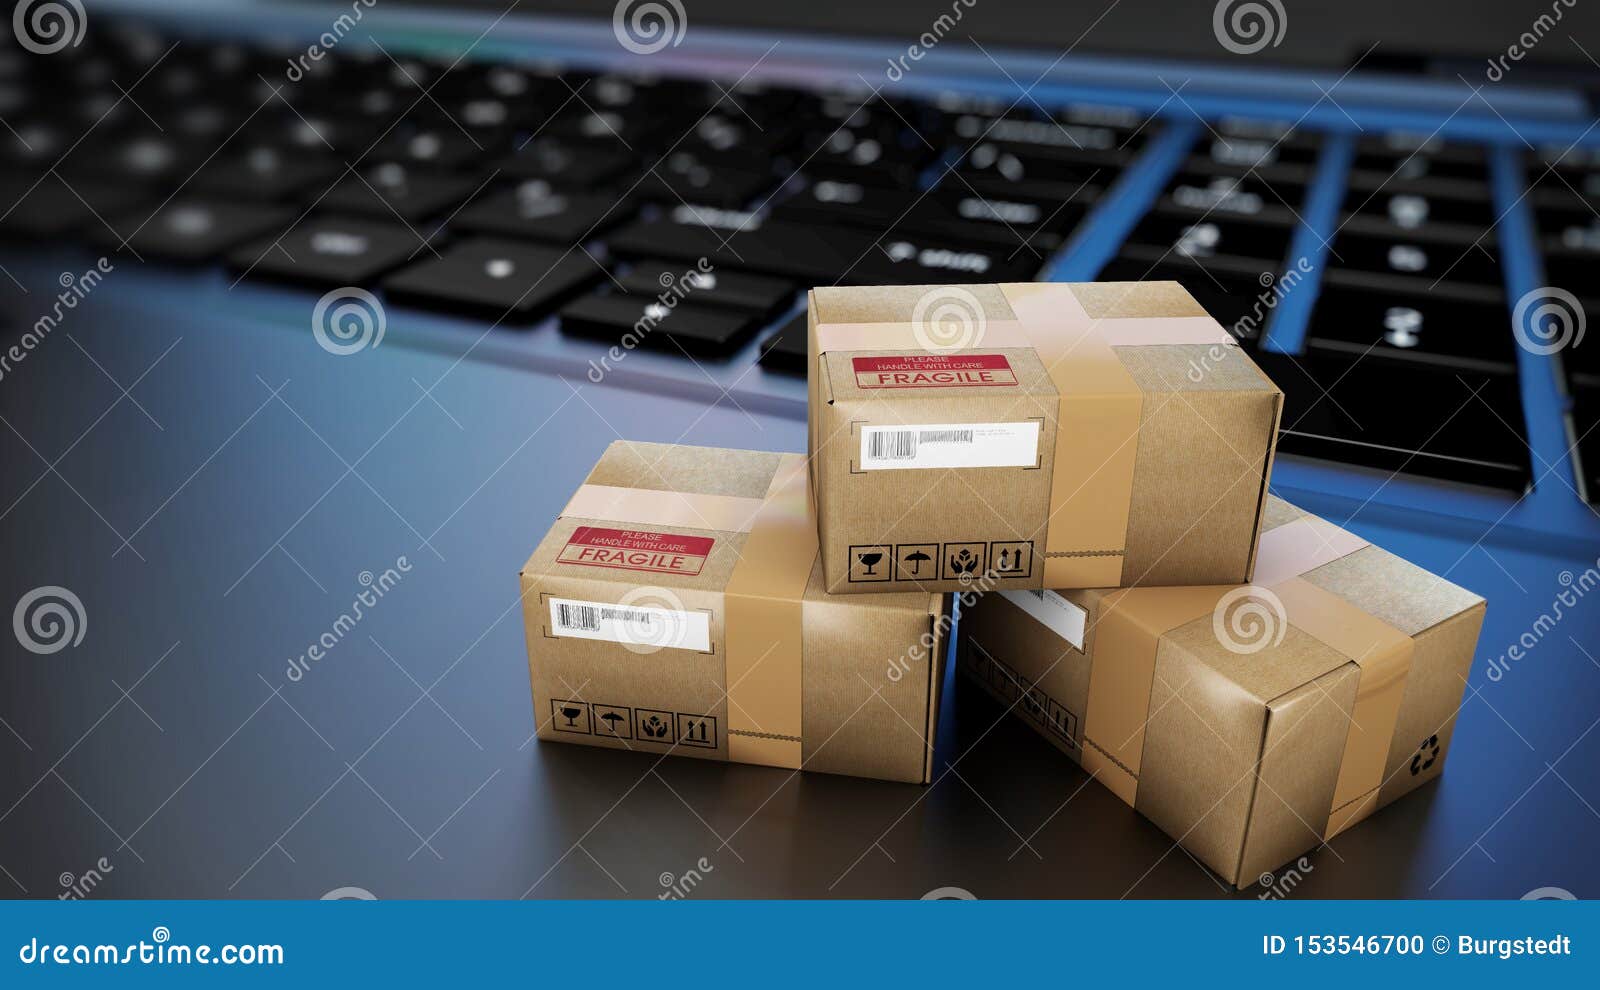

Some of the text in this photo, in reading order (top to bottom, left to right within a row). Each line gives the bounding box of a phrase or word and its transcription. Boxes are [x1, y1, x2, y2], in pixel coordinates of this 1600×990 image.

[903, 355, 950, 364] PLEASE
[877, 363, 921, 371] HANDLE
[952, 362, 984, 370] CARE
[878, 371, 994, 385] FRAGILE
[621, 531, 663, 542] PLEASE
[590, 537, 688, 552] HANDLE WITH CARE
[578, 547, 686, 569] FRAGILE
